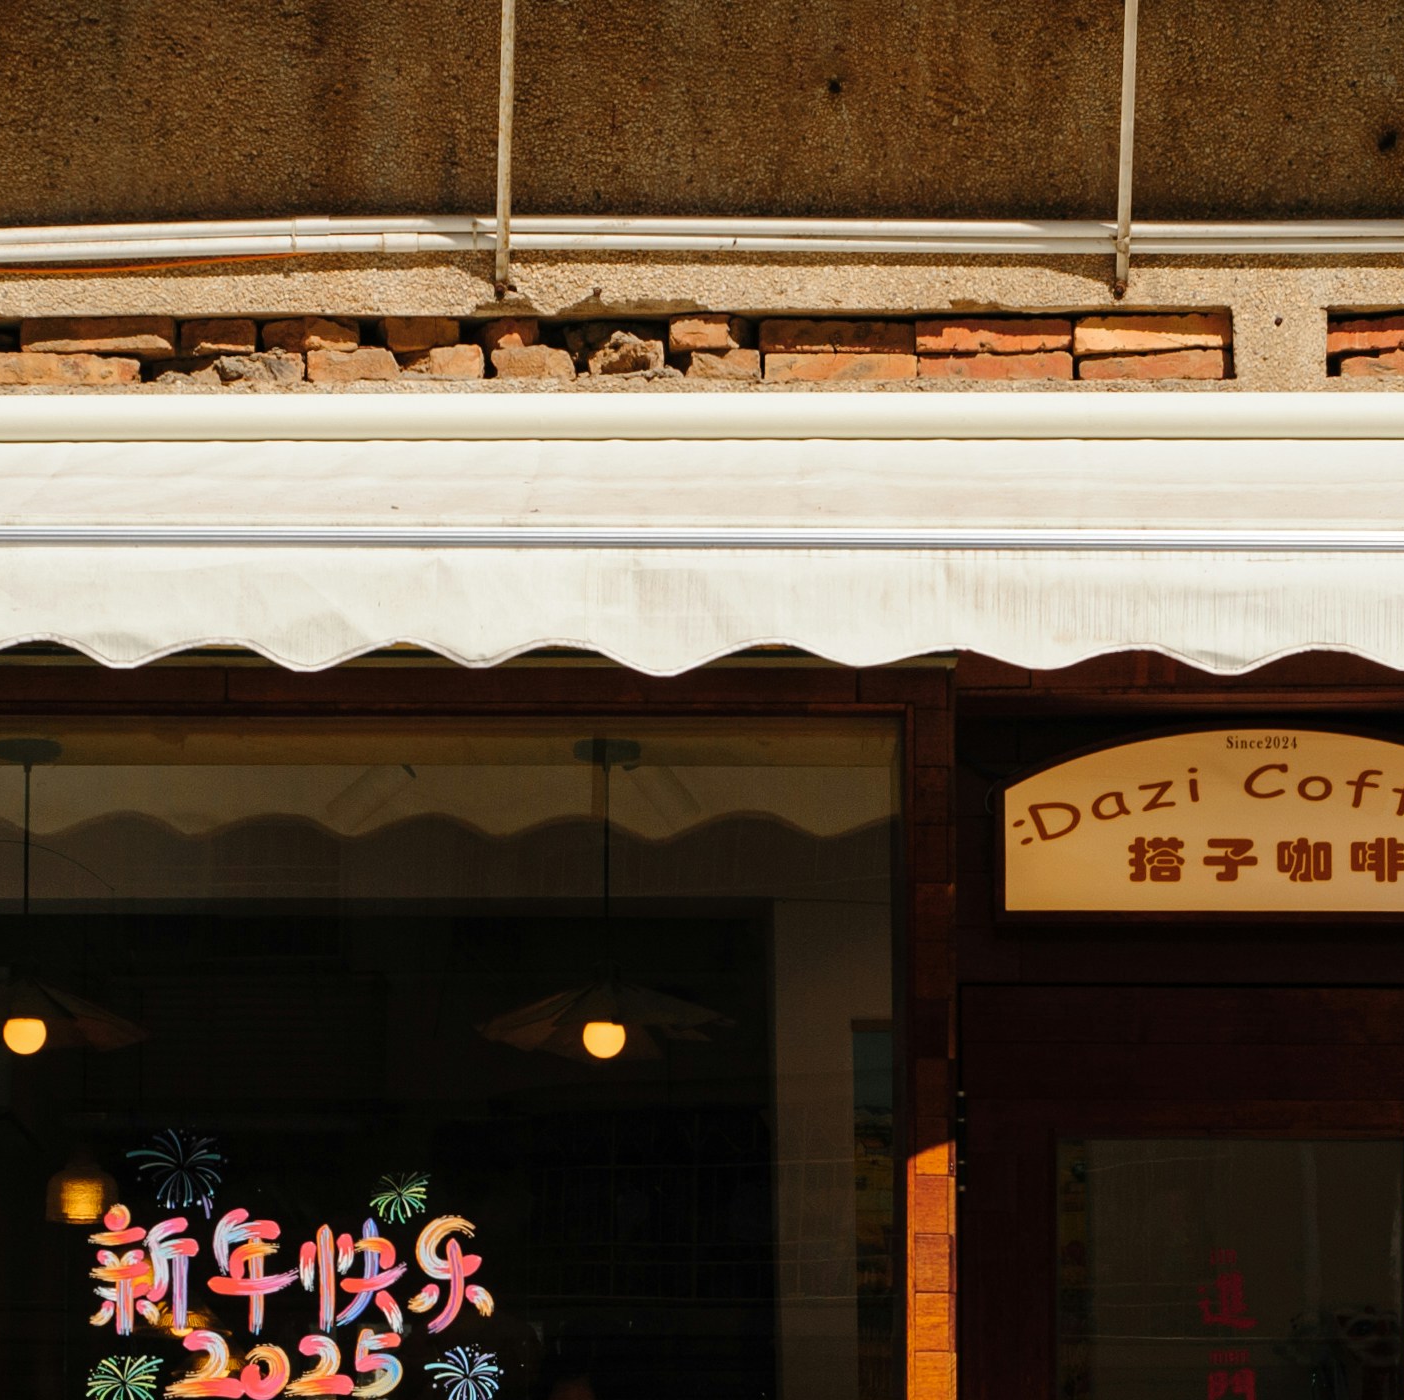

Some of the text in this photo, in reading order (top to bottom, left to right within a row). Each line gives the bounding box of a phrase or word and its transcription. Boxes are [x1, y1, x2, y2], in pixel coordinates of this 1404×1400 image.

[1225, 735, 1299, 751] Since2024
[87, 1203, 495, 1336] 新年快乐
[163, 1328, 403, 1400] 2025
